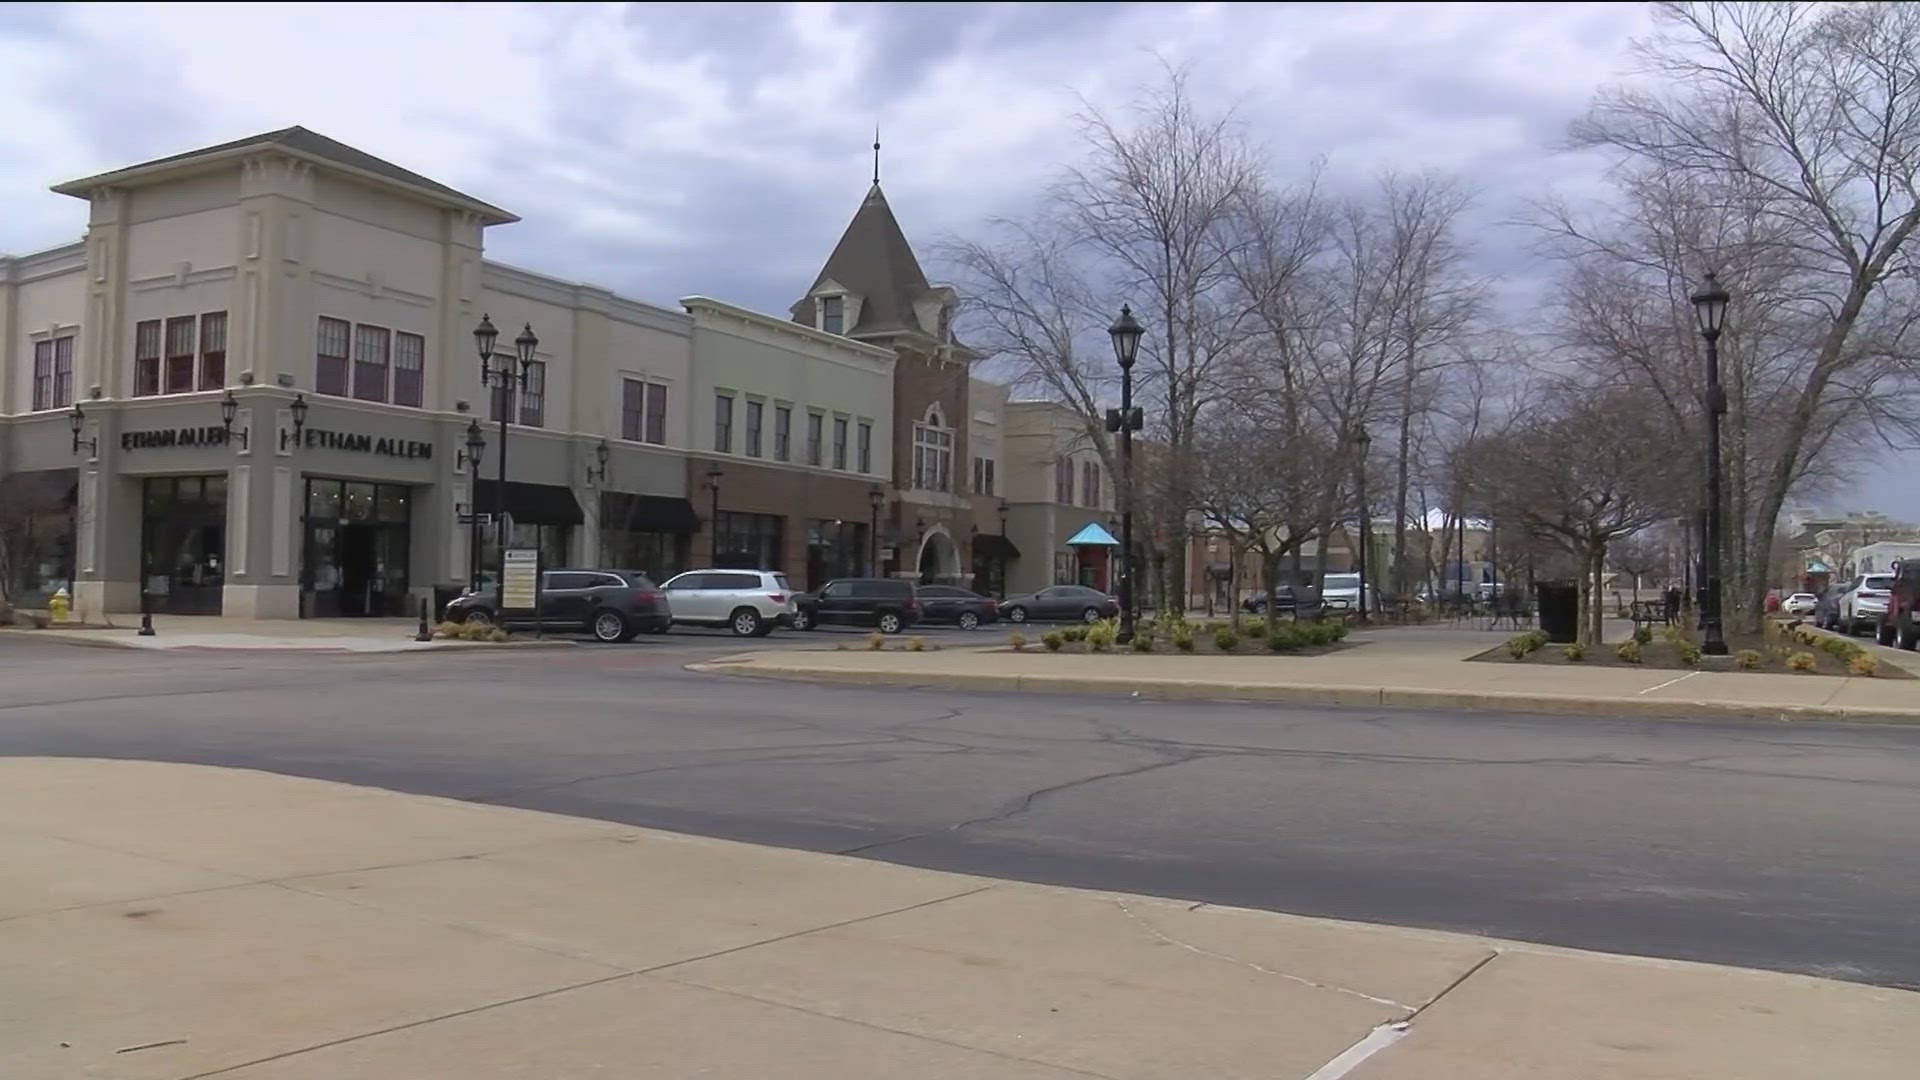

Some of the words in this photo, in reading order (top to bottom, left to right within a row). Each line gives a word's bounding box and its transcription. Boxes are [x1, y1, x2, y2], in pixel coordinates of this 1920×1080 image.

[121, 429, 177, 450] ETHAN
[305, 429, 371, 453] ETHAN
[375, 437, 432, 459] ALLEN
